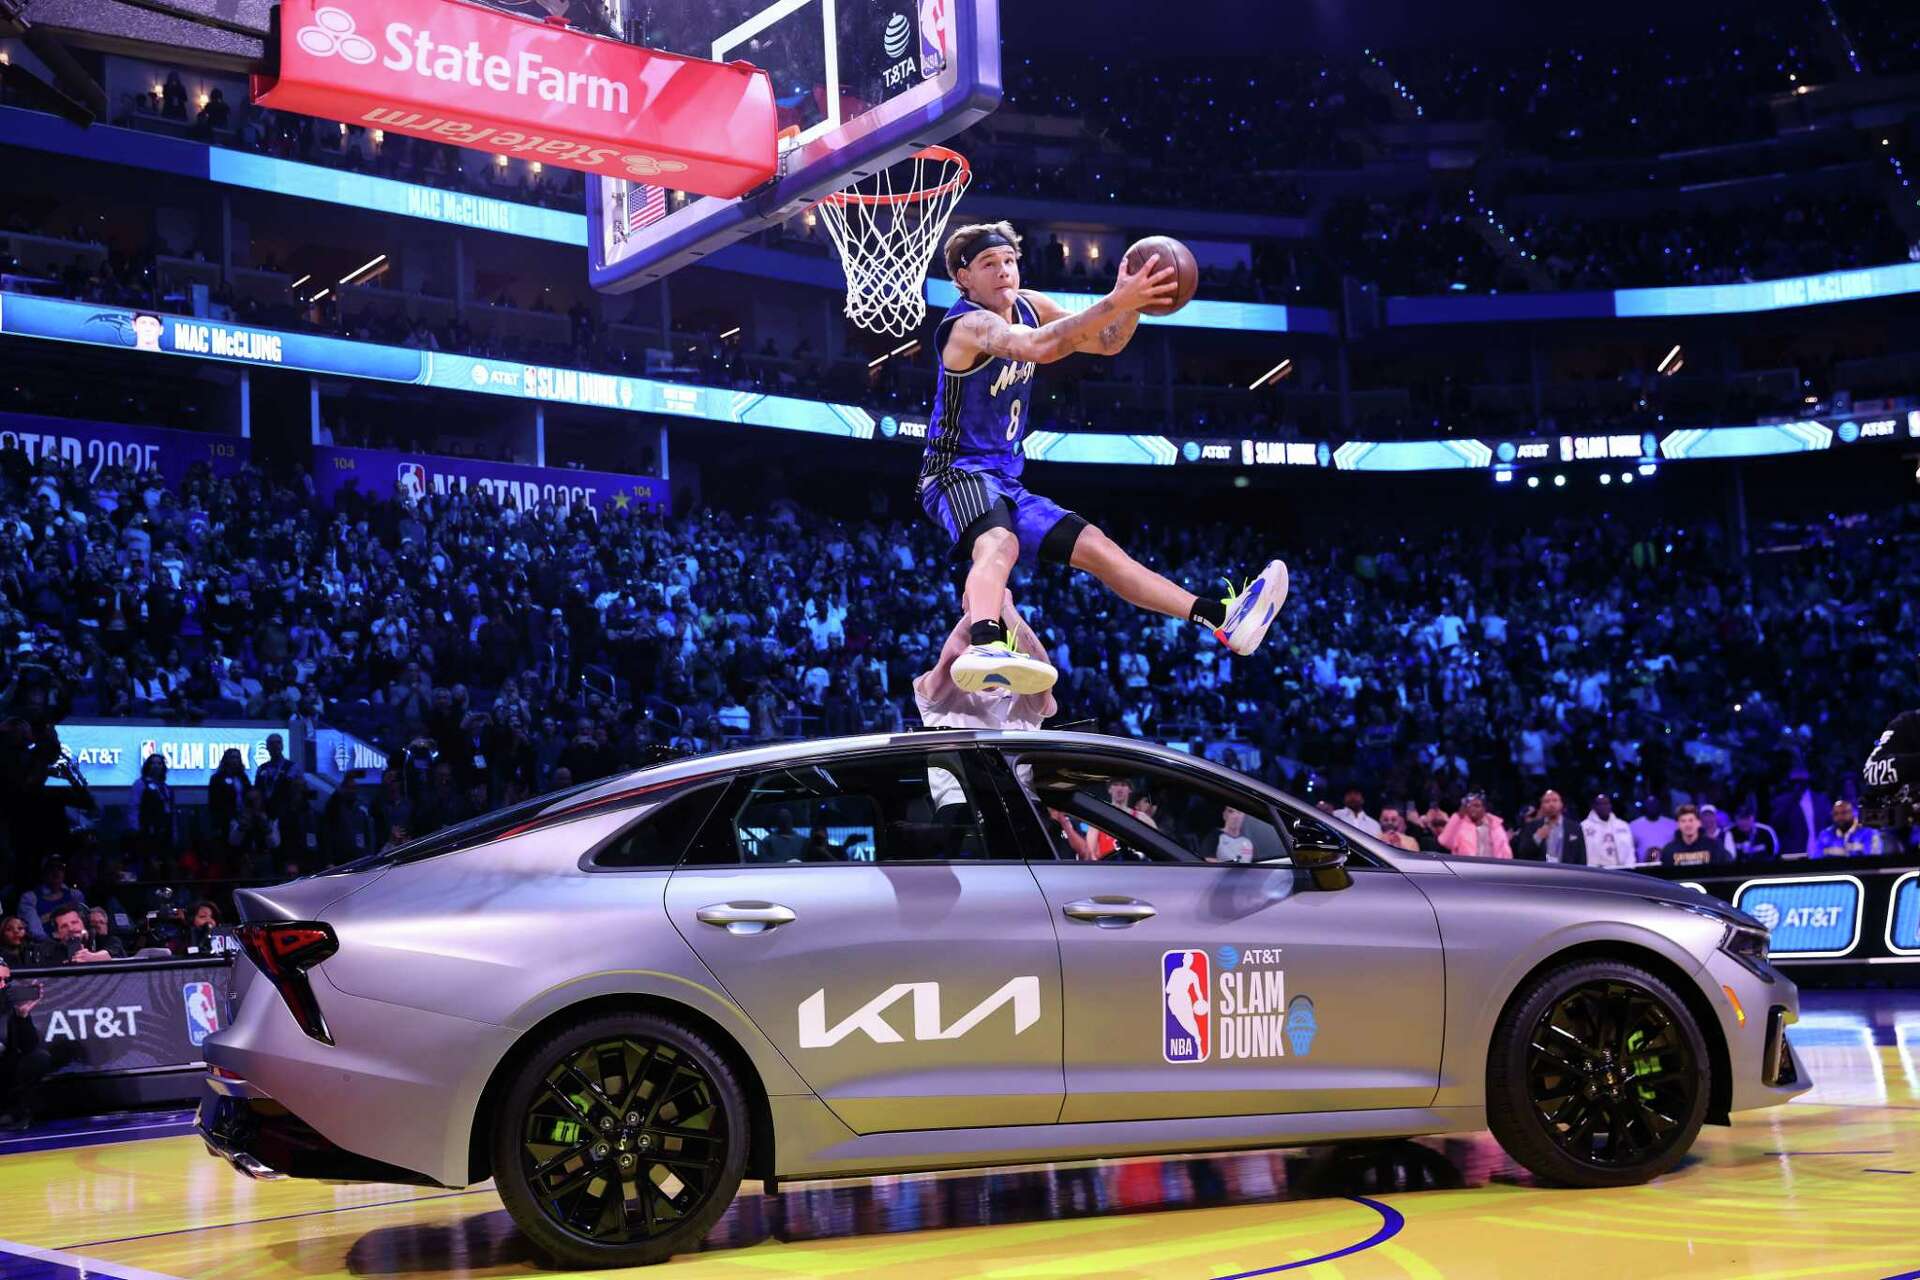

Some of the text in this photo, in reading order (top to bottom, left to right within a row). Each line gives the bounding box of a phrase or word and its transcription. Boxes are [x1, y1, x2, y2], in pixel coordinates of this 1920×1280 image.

[174, 322, 282, 362] MAC McCLUNG
[537, 366, 577, 400] SLAM
[578, 373, 618, 406] DUNK
[898, 422, 928, 437] AT&T
[1006, 399, 1021, 441] 8
[1861, 420, 1897, 437] AT&T
[1201, 445, 1232, 459] AT&T
[632, 485, 652, 498] 104
[78, 747, 122, 764] AT&T
[162, 741, 204, 770] SLAM
[1783, 907, 1842, 928] AT&T
[1242, 949, 1283, 965] AT&T
[1219, 970, 1285, 1015] SLAM
[45, 1005, 142, 1042] AT&T
[798, 976, 1041, 1048] KIA
[1170, 1038, 1193, 1056] NBA
[1220, 1014, 1285, 1059] DUNK
